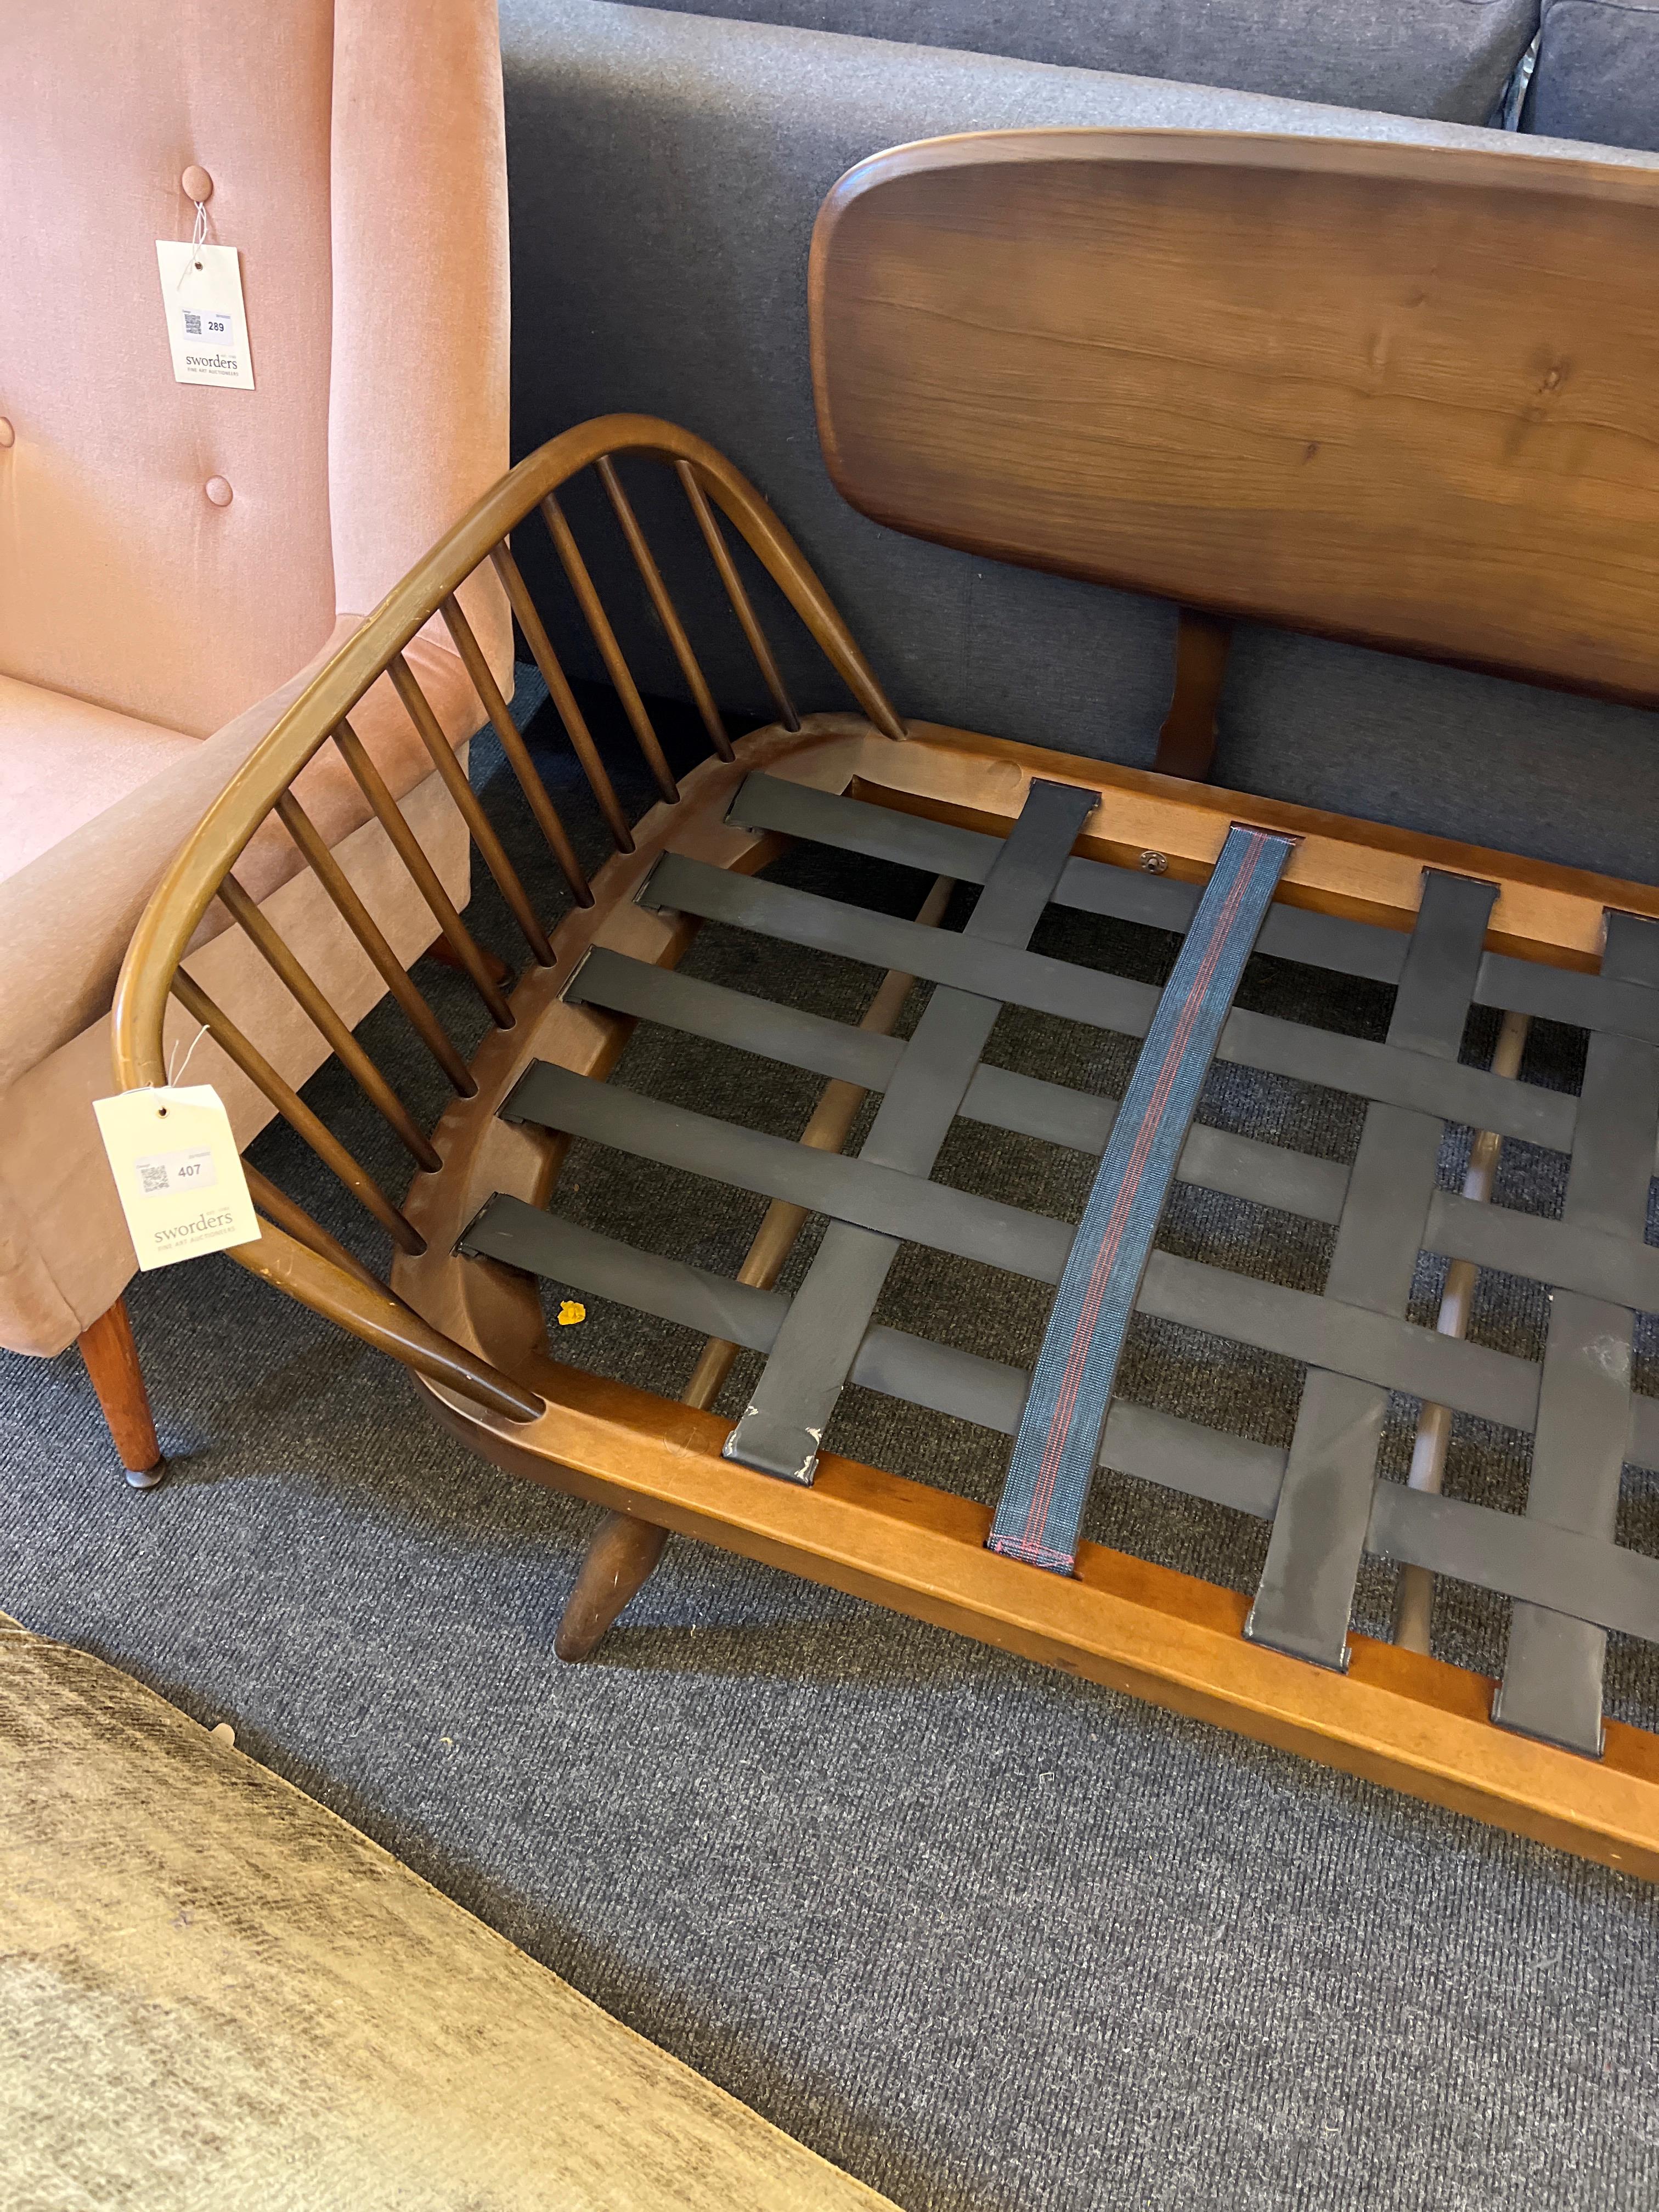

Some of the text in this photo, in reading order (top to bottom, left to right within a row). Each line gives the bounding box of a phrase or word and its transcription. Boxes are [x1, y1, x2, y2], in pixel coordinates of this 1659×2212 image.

[208, 321, 224, 332] 289
[186, 354, 238, 369] sworders
[178, 1164, 201, 1177] 407
[154, 1213, 233, 1243] sworders
[175, 1239, 187, 1247] ART
